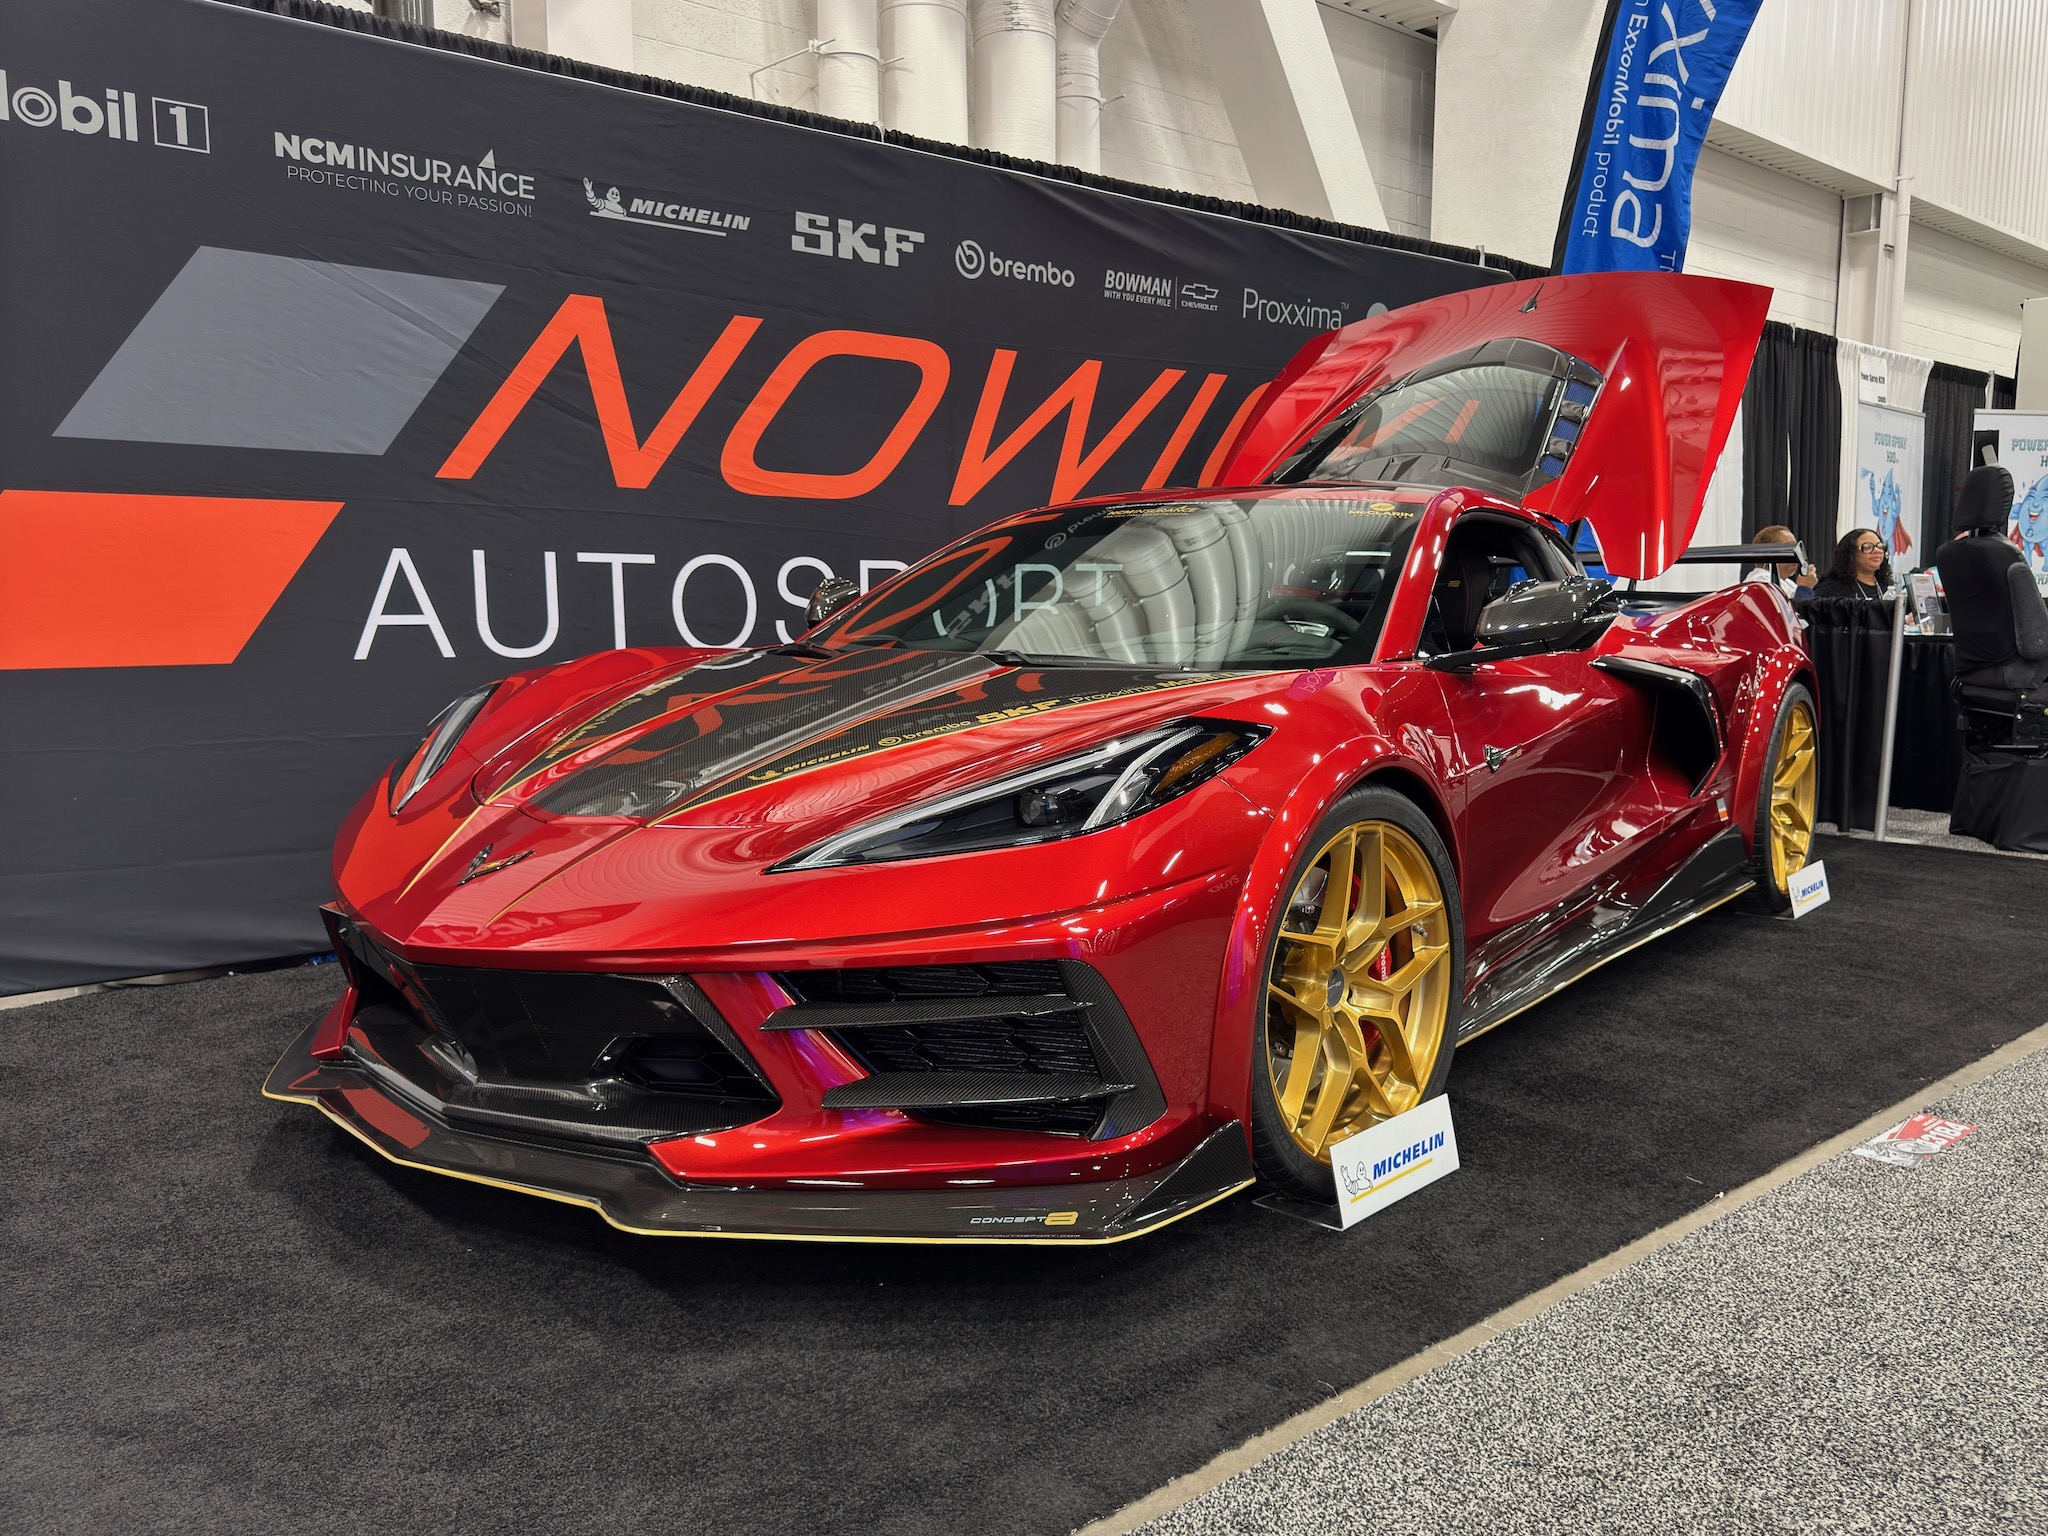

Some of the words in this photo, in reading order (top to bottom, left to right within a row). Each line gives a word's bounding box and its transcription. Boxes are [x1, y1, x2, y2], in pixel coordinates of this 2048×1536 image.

[1602, 13, 1649, 145] ExxonMobil
[287, 165, 400, 196] PROTECTING
[404, 184, 453, 206] YOUR
[458, 193, 533, 218] PASSION!
[1582, 152, 1611, 238] product
[629, 197, 752, 232] MICHELIN
[791, 211, 926, 267] SKF
[990, 250, 1076, 288] brembo
[1104, 269, 1172, 298] BOWMAN
[1104, 289, 1121, 300] WITH
[1122, 292, 1135, 303] YOU
[1135, 294, 1156, 306] EVERY
[1156, 298, 1172, 308] MILE
[1181, 300, 1219, 312] CHEVROLET
[1242, 287, 1343, 331] Proxxima
[783, 744, 870, 772] MICHELIN
[902, 719, 973, 740] brembo
[976, 699, 1061, 724] SKF
[1800, 879, 1824, 898] MICHELIN
[1373, 1130, 1445, 1181] MICHELIN
